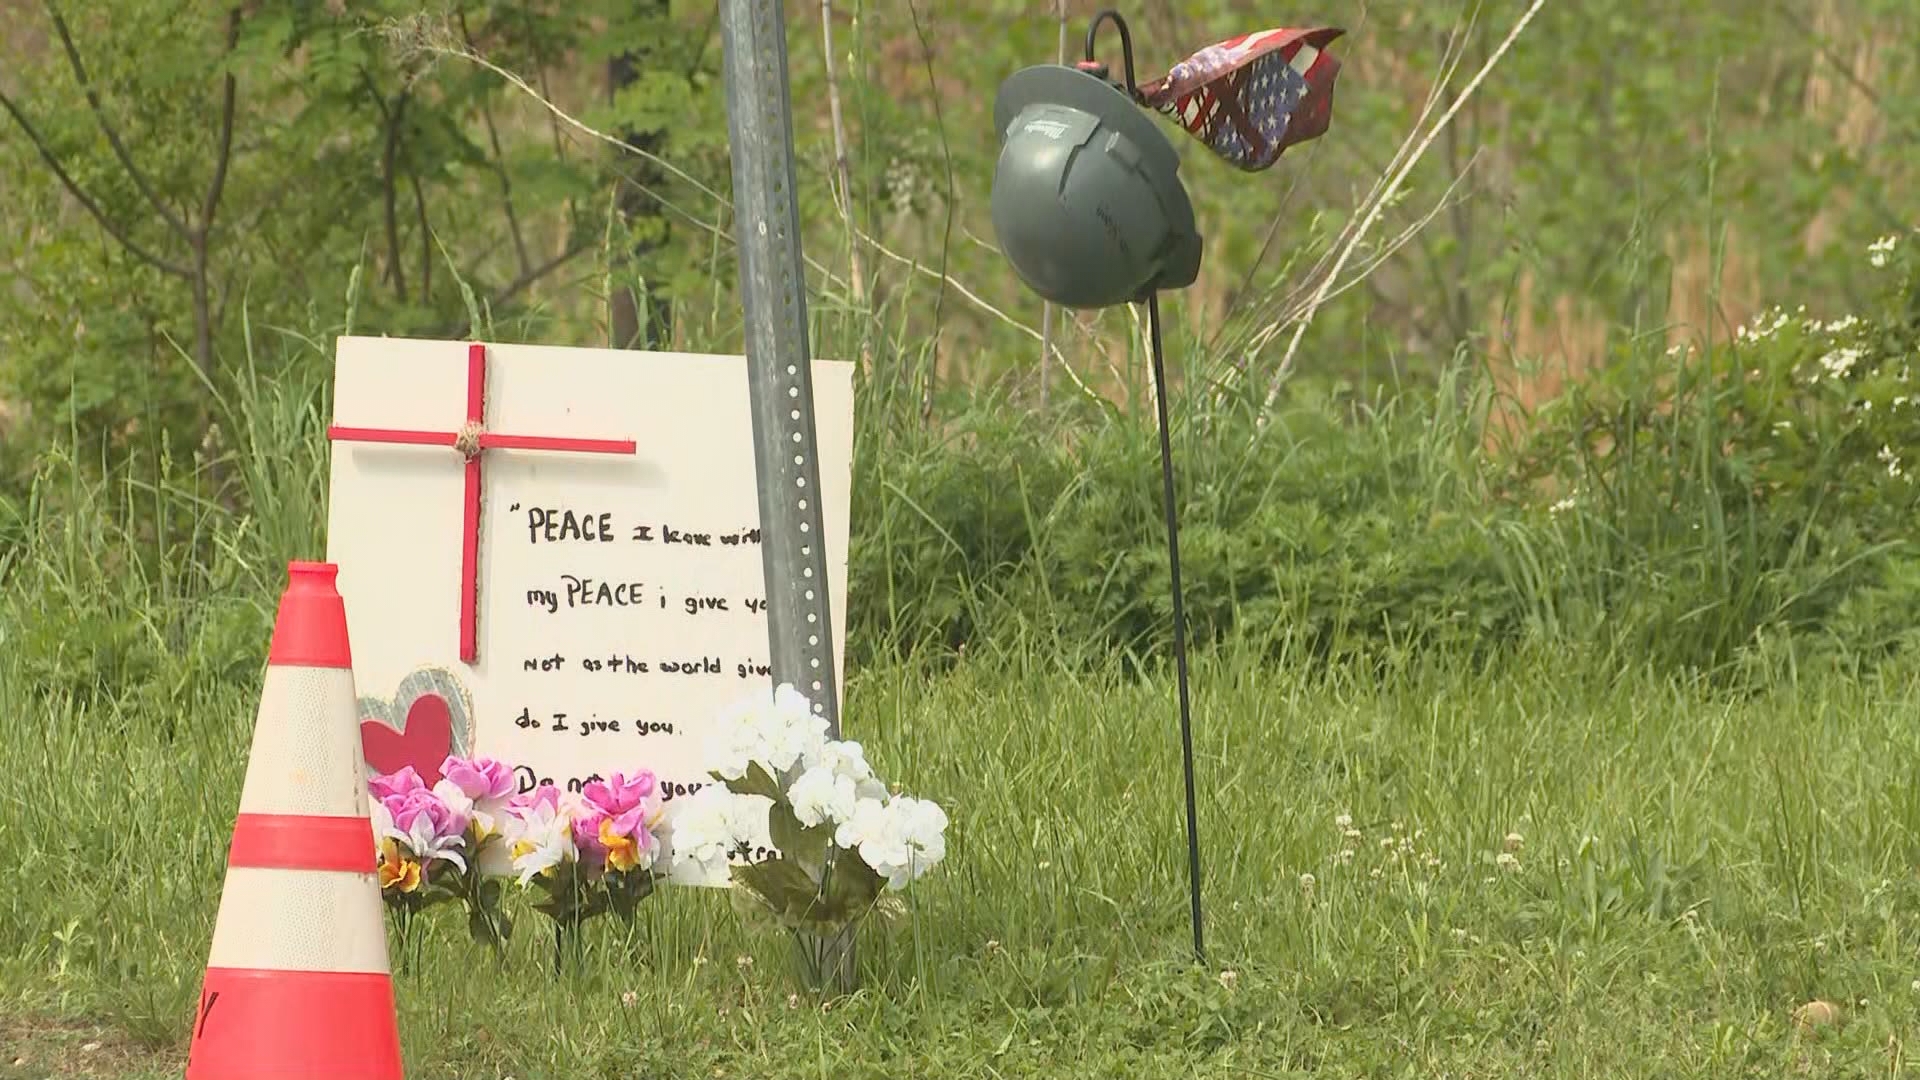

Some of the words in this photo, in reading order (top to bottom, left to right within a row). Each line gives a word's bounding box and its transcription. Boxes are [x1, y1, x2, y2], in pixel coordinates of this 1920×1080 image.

[632, 525, 653, 542] I
[663, 525, 711, 546] leave
[526, 589, 557, 613] my
[561, 575, 643, 608] PEACE
[659, 586, 666, 609] i
[685, 590, 728, 614] give
[745, 598, 767, 614] yo
[660, 657, 721, 674] world
[515, 707, 540, 729] do
[552, 714, 568, 732] I
[580, 714, 620, 736] give
